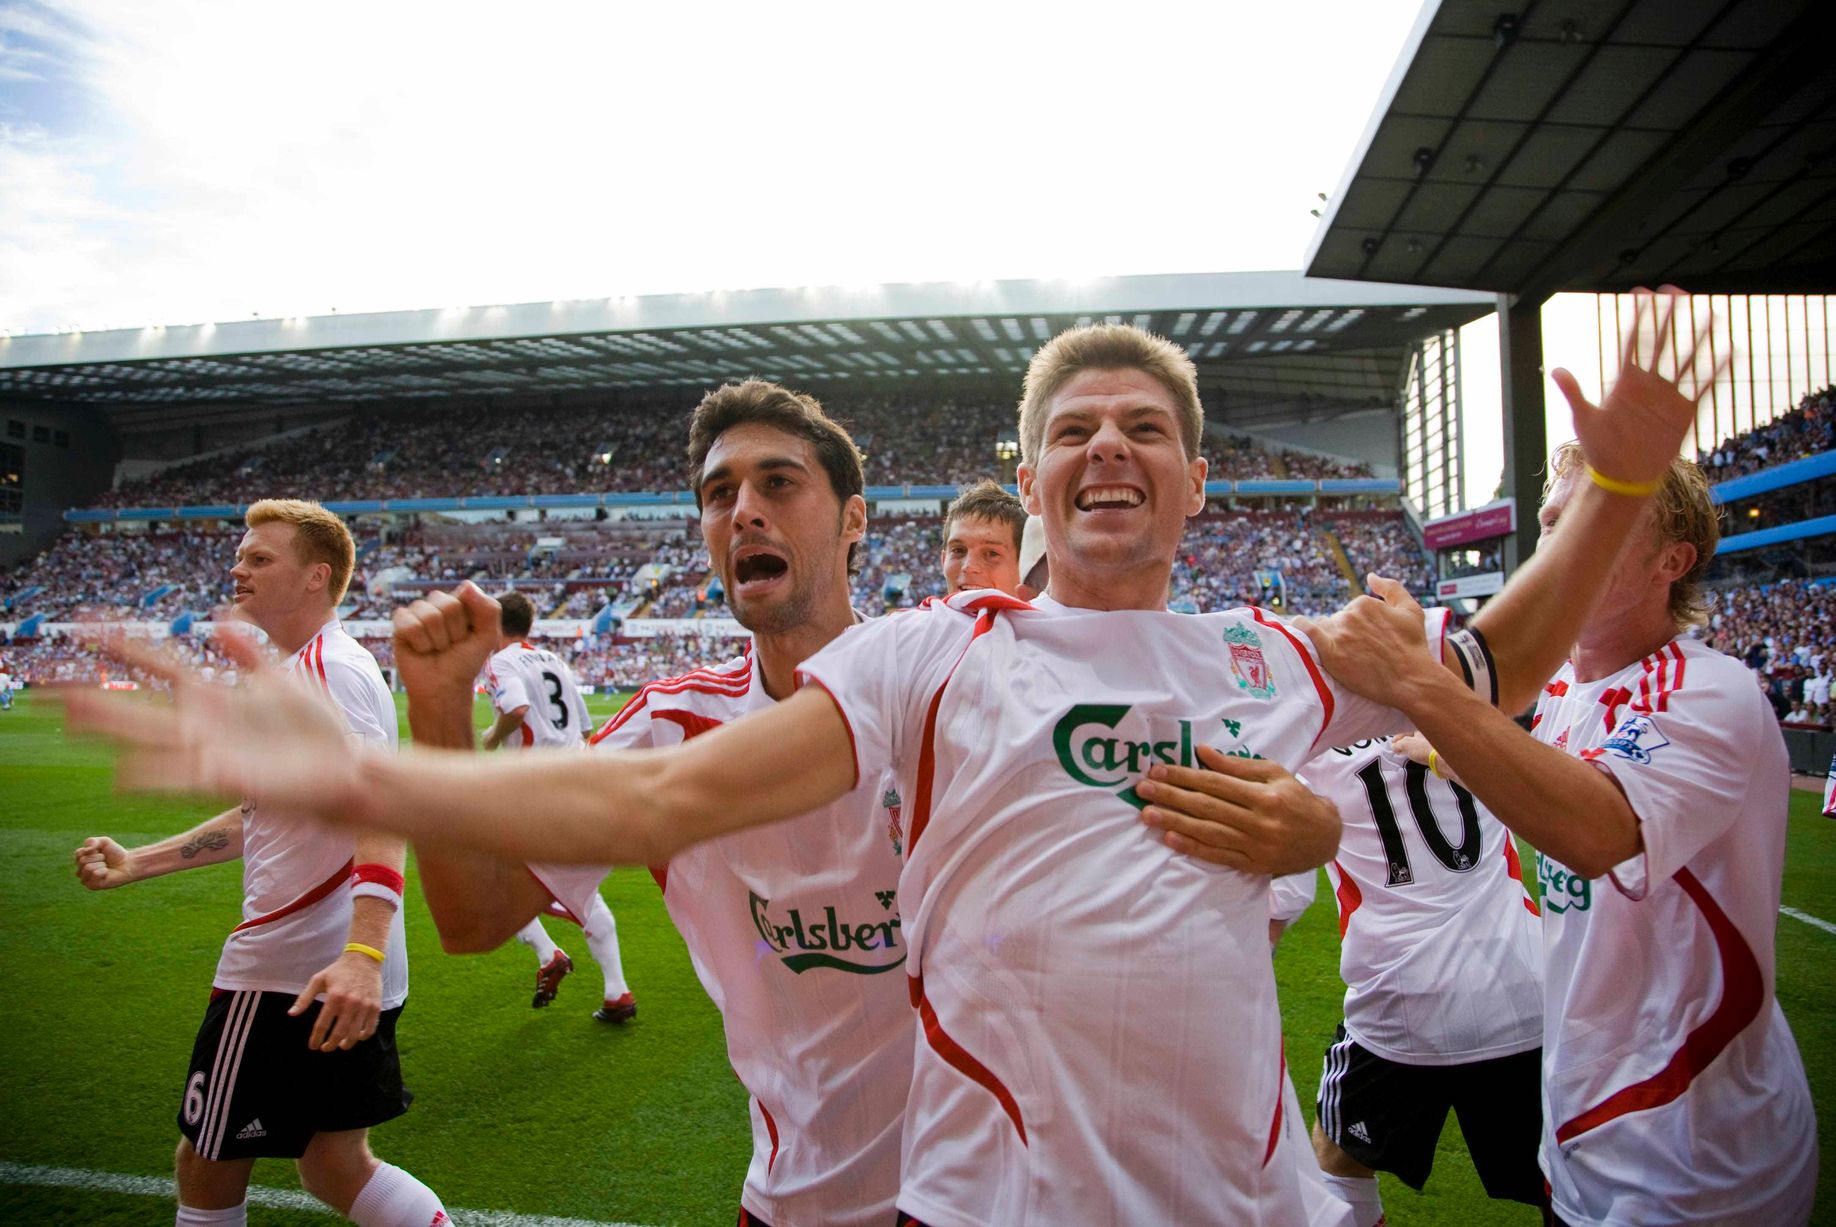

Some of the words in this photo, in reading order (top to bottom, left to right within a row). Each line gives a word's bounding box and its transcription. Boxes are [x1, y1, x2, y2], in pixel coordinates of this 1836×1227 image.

[542, 672, 568, 730] 3
[1354, 755, 1483, 888] 10
[184, 1070, 206, 1126] 6
[236, 1129, 267, 1139] adidas
